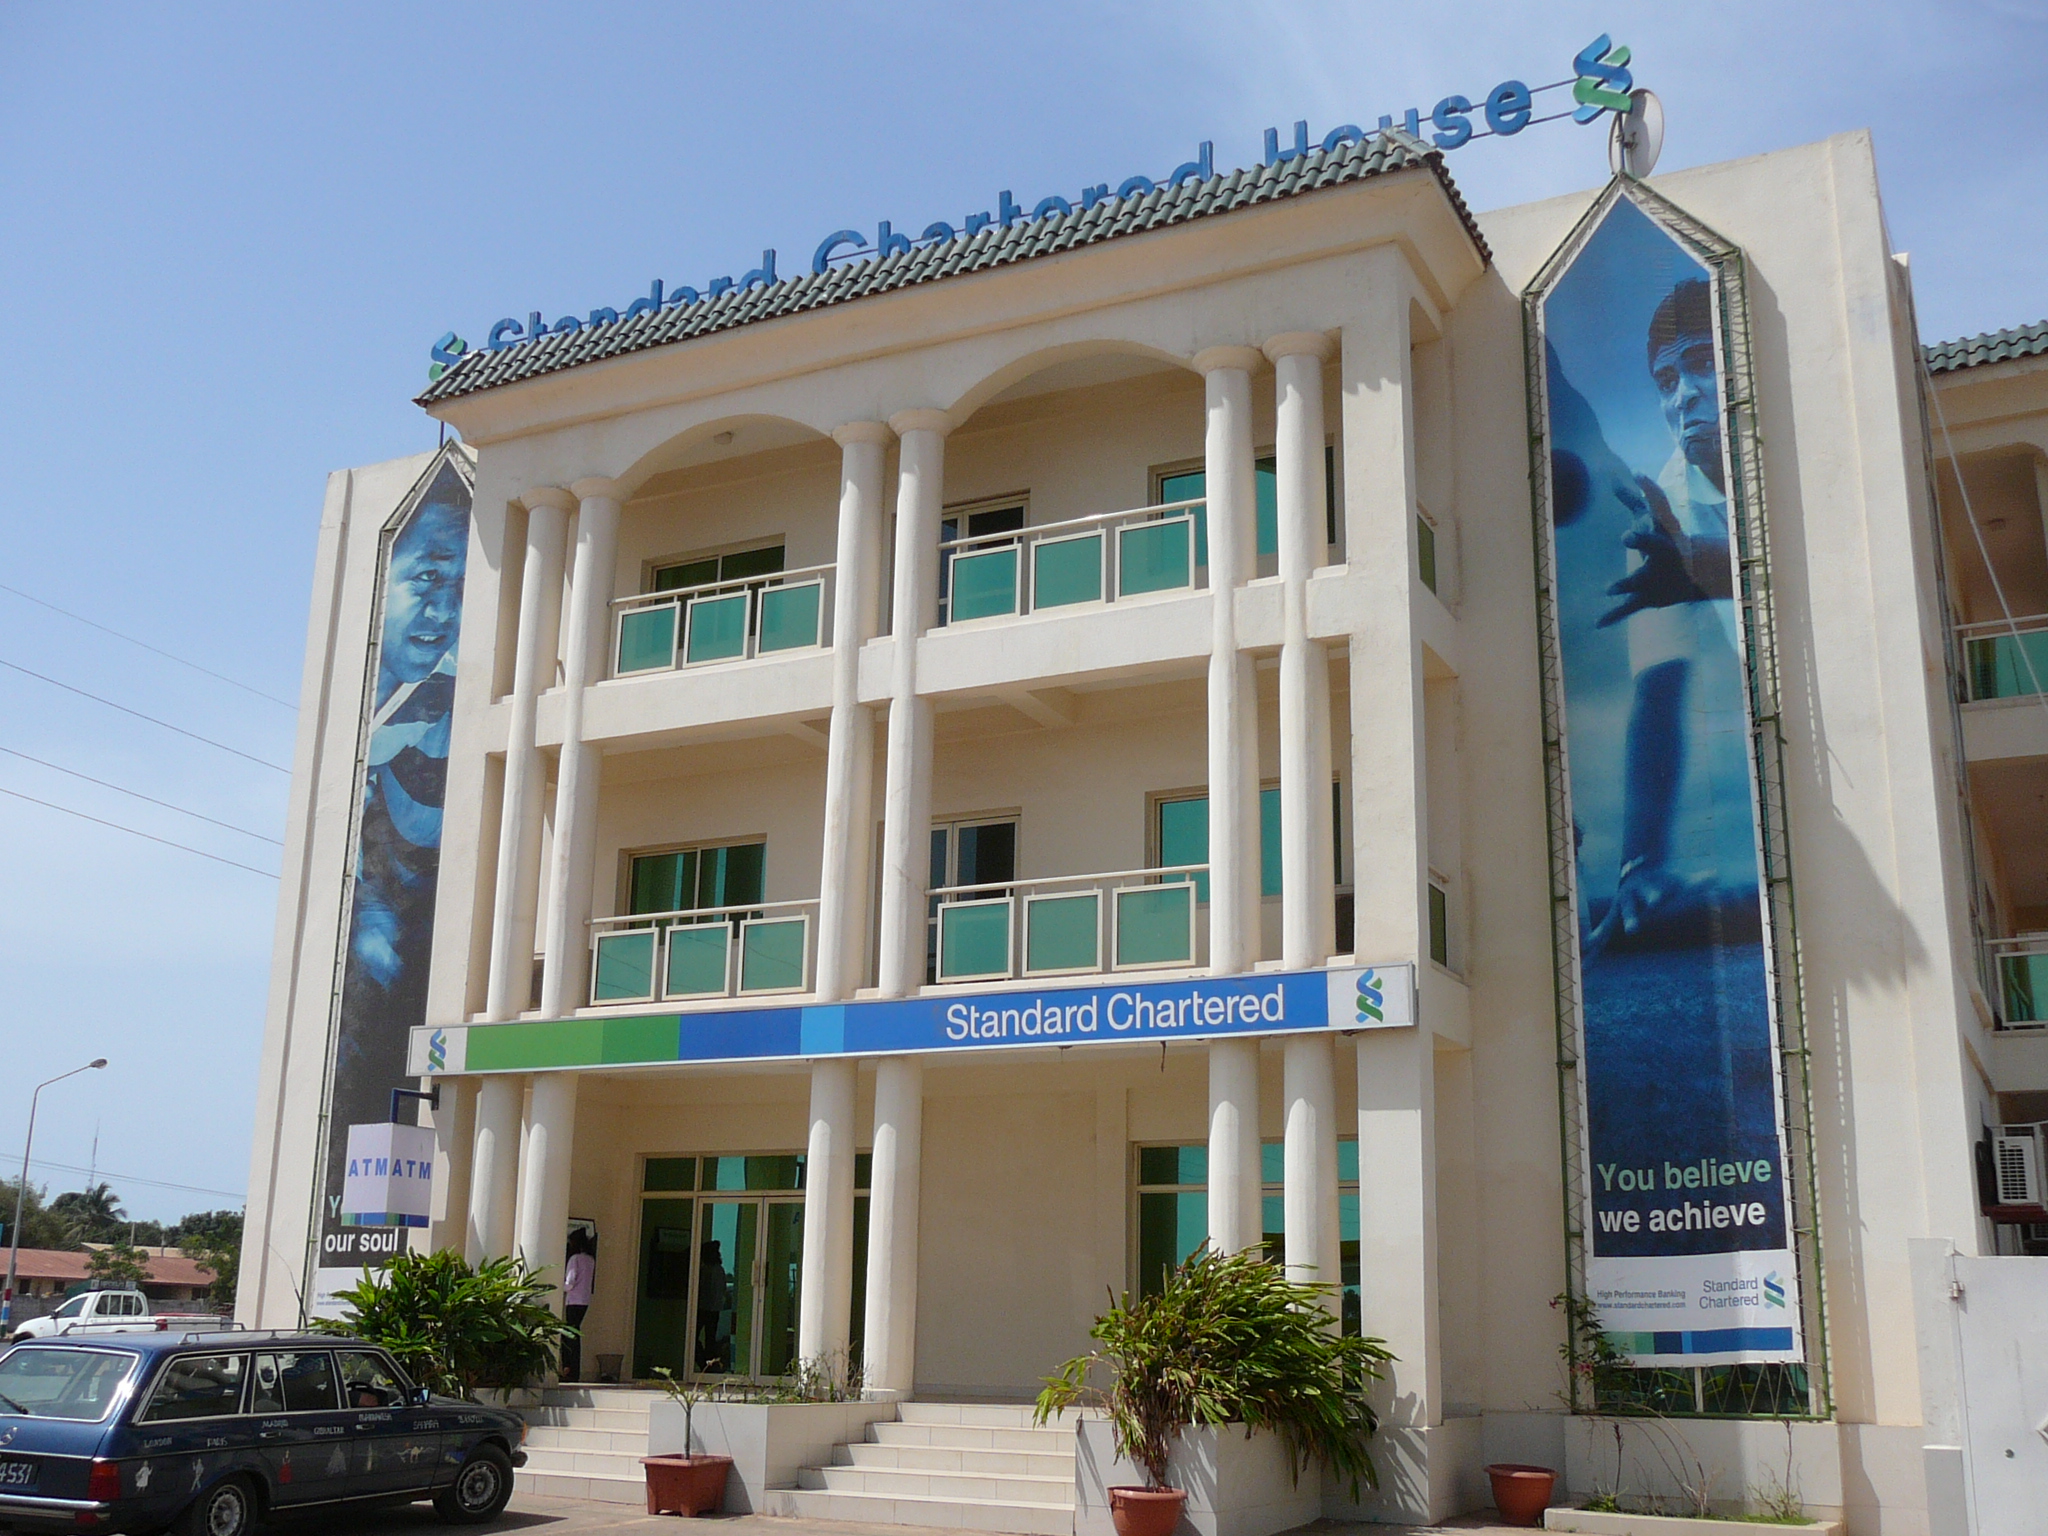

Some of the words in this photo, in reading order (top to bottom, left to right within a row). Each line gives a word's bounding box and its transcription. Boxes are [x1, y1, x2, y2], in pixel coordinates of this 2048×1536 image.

[946, 996, 1098, 1040] Standard
[1107, 983, 1284, 1031] Chartered
[348, 1158, 388, 1176] ATM
[392, 1159, 431, 1180] ATM
[1597, 1163, 1654, 1191] You
[1664, 1158, 1771, 1189] believe
[1599, 1209, 1640, 1233] we
[1649, 1200, 1766, 1232] achieve
[325, 1232, 355, 1253] our
[359, 1228, 398, 1252] soul
[1597, 1290, 1613, 1300] High
[1614, 1289, 1656, 1299] Performance
[1657, 1289, 1686, 1300] Banking
[1703, 1277, 1759, 1293] Standard
[1597, 1301, 1686, 1309] www.standardchartered.com
[1699, 1293, 1759, 1309] Chartered
